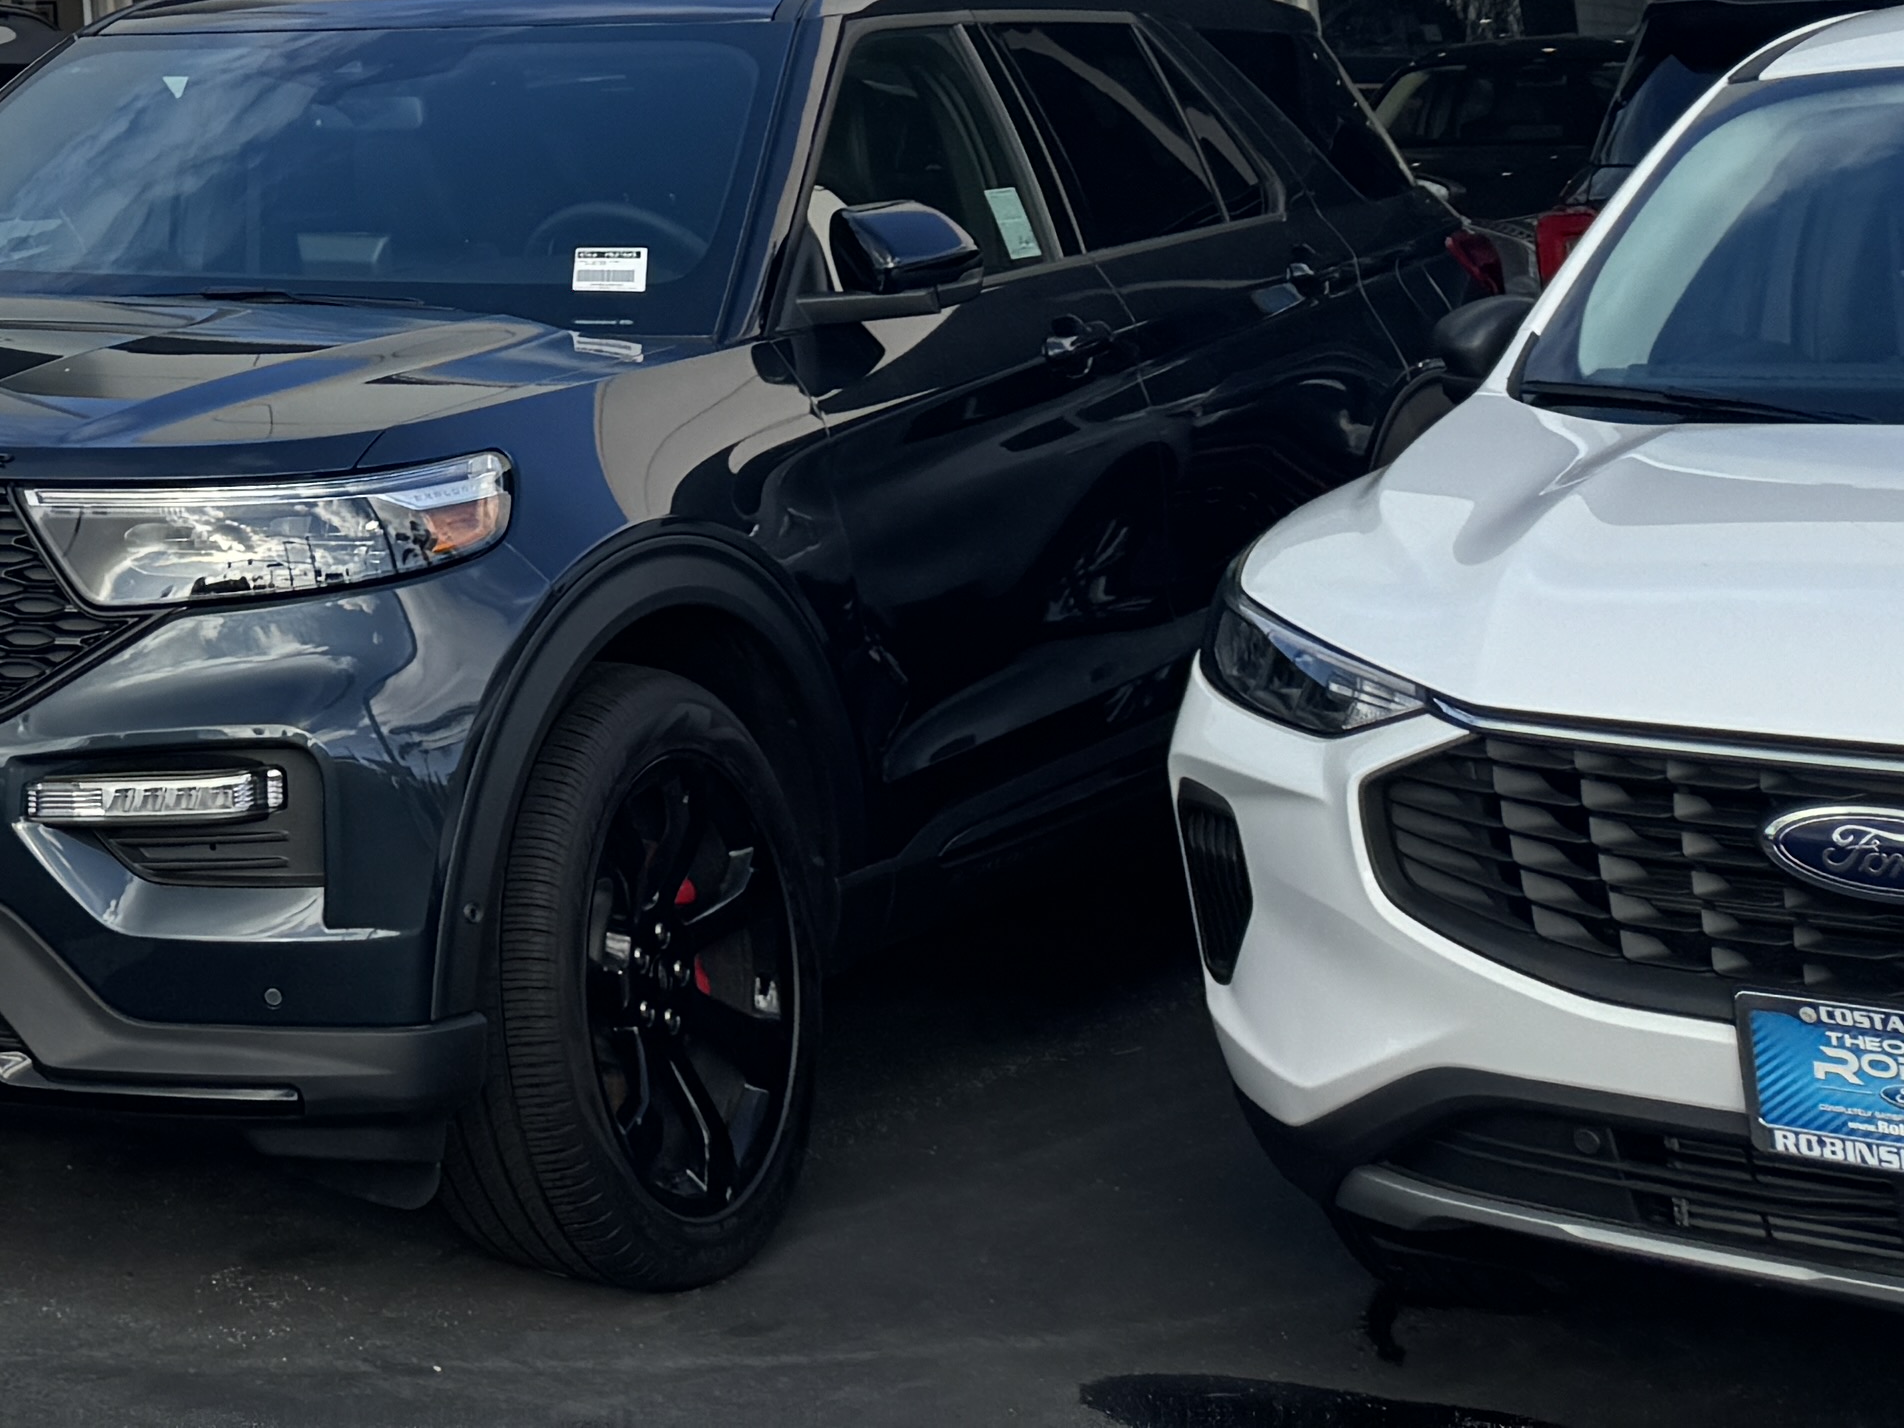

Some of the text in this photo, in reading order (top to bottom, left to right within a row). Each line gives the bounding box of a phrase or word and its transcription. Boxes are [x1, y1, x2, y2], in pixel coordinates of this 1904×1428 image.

[1819, 1006, 1904, 1034] COSTA
[1813, 1046, 1904, 1086] RO
[1773, 1130, 1904, 1172] ROBINS
